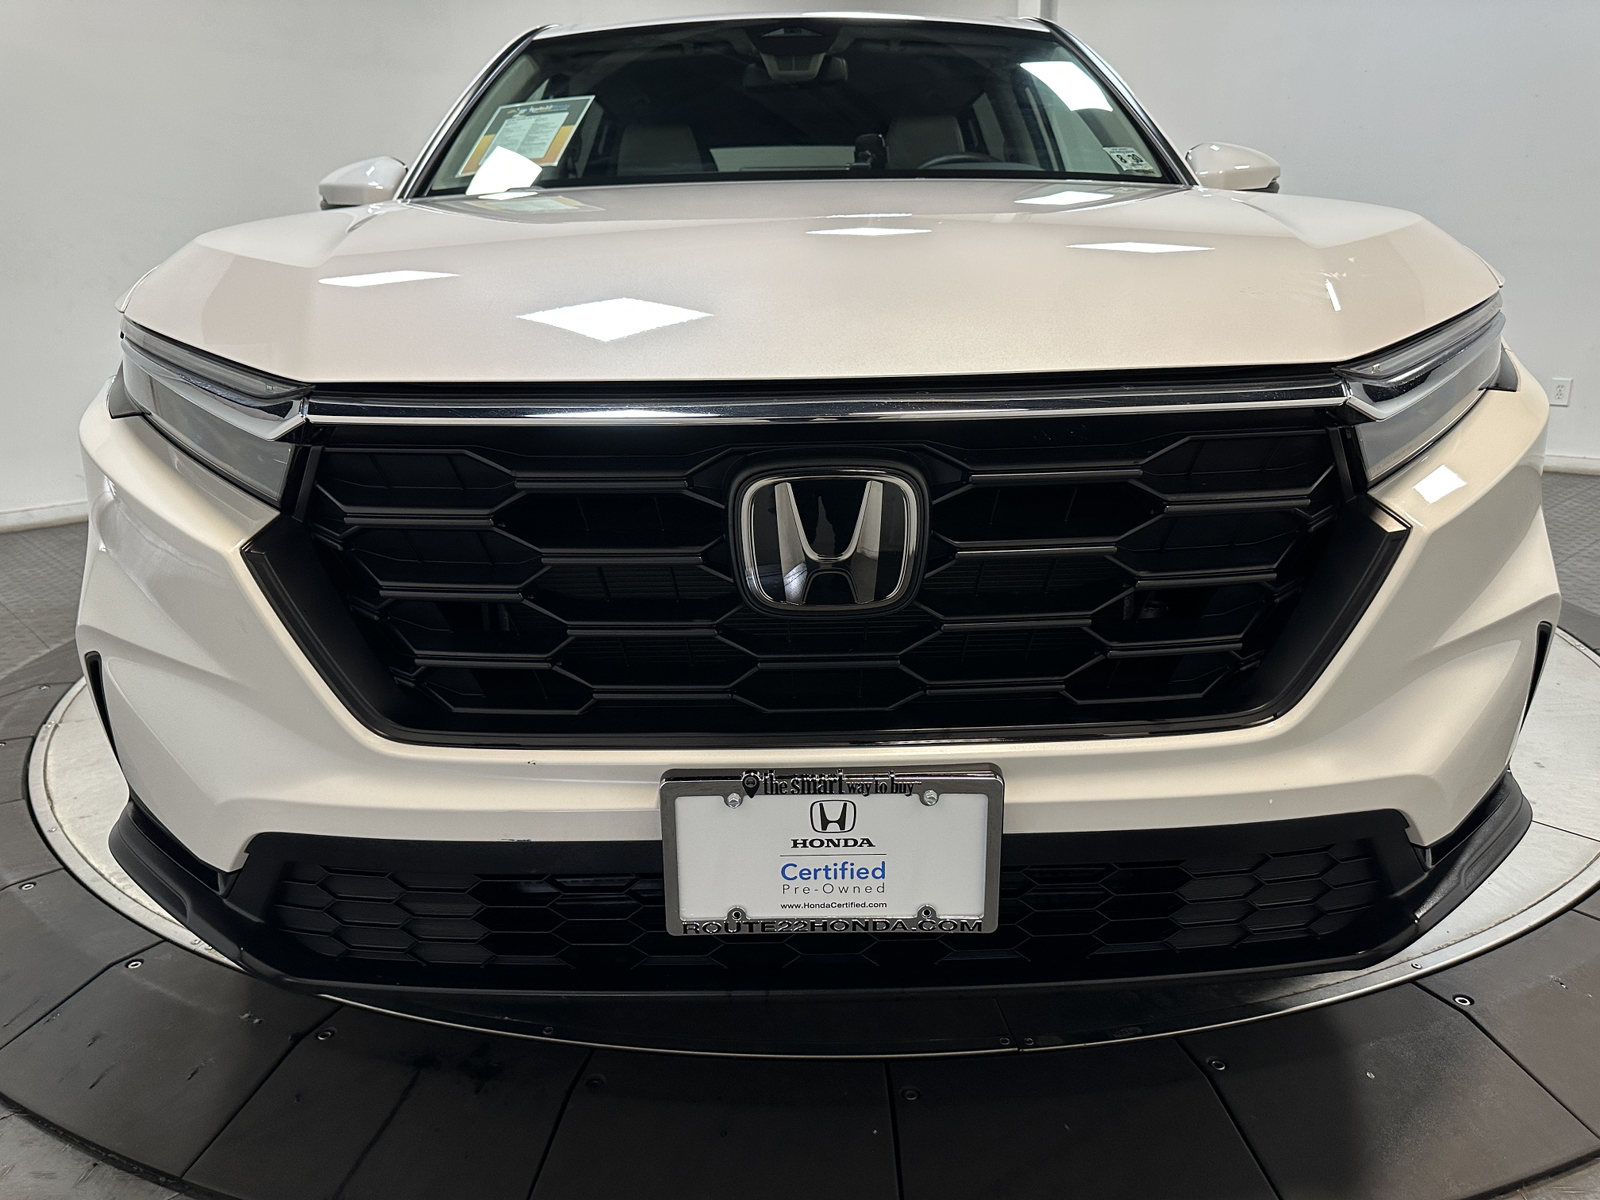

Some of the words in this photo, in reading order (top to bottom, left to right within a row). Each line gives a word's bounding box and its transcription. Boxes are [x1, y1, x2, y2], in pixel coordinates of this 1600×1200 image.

[764, 770, 788, 795] the
[790, 769, 846, 795] smart
[847, 781, 874, 796] way
[874, 780, 888, 794] to
[890, 771, 915, 796] buy
[791, 838, 876, 848] HONDA
[780, 861, 886, 881] Certified
[782, 882, 885, 895] Pre-Owned
[780, 901, 887, 910] www.HondaCertified.com
[682, 919, 984, 935] ROUTE22HONDA.COM
